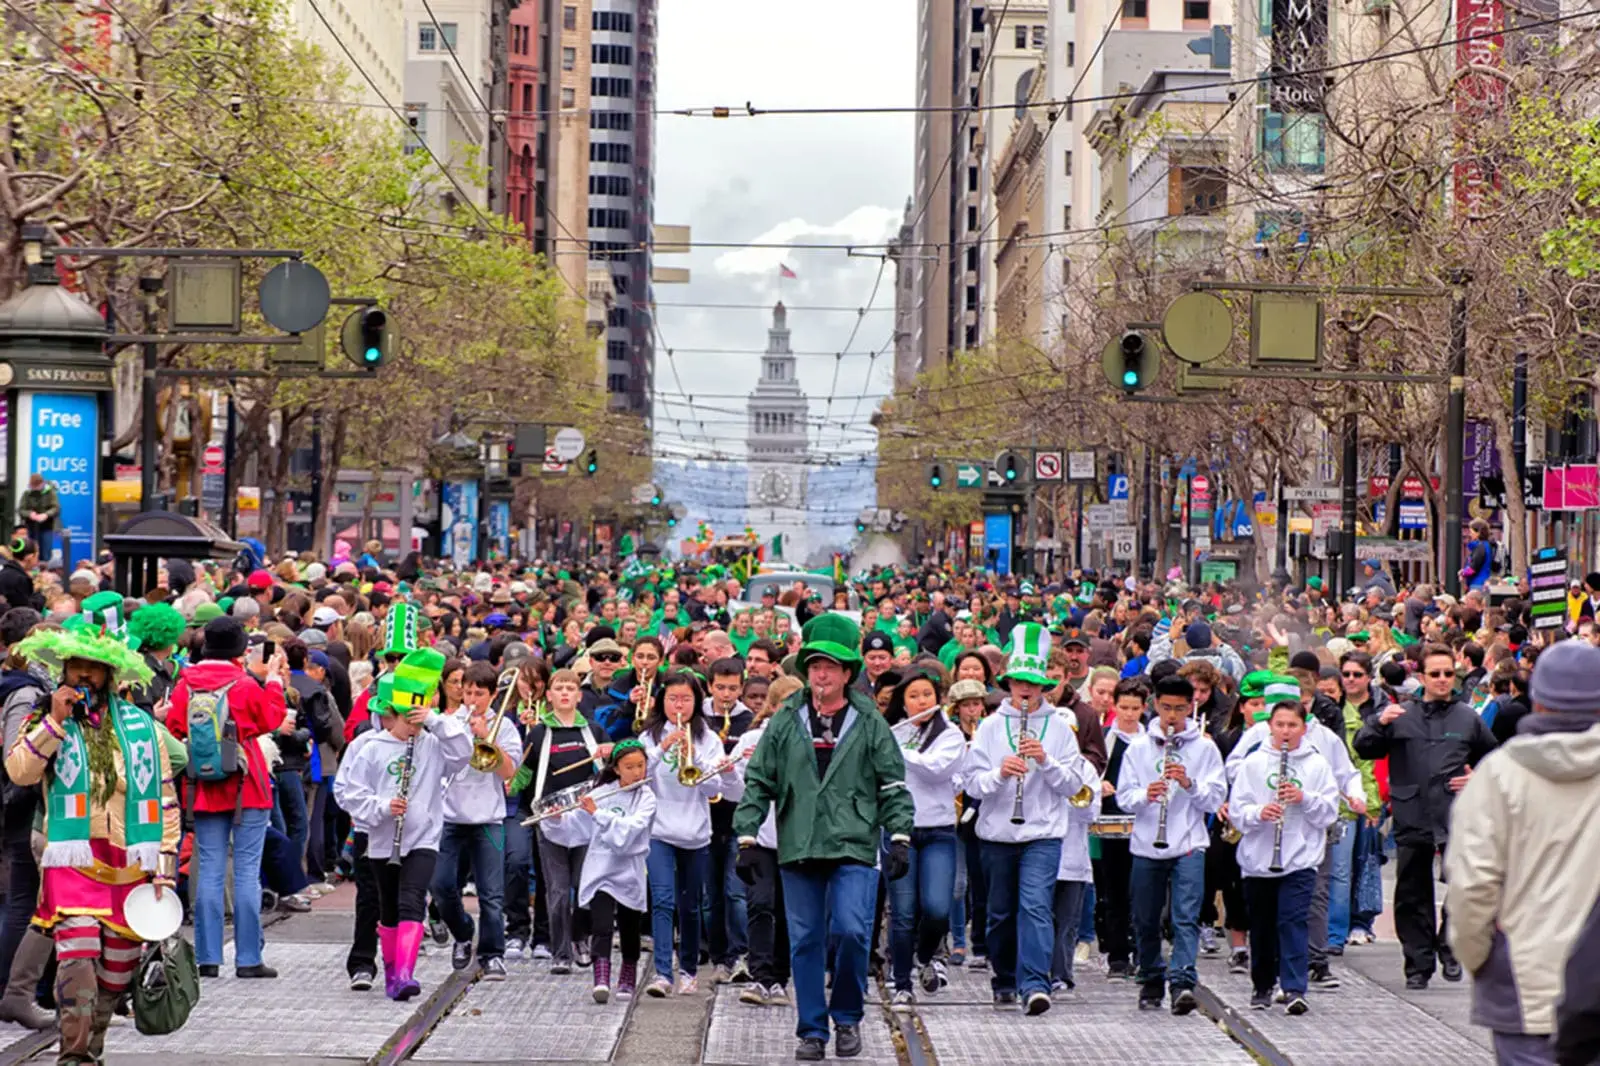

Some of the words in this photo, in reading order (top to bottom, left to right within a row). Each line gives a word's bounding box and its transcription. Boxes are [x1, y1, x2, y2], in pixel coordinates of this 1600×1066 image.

[27, 368, 52, 380] SAN
[38, 408, 82, 428] Free
[37, 434, 65, 453] up
[37, 456, 88, 474] purse
[1294, 490, 1329, 498] POWELL
[1117, 542, 1132, 553] 10
